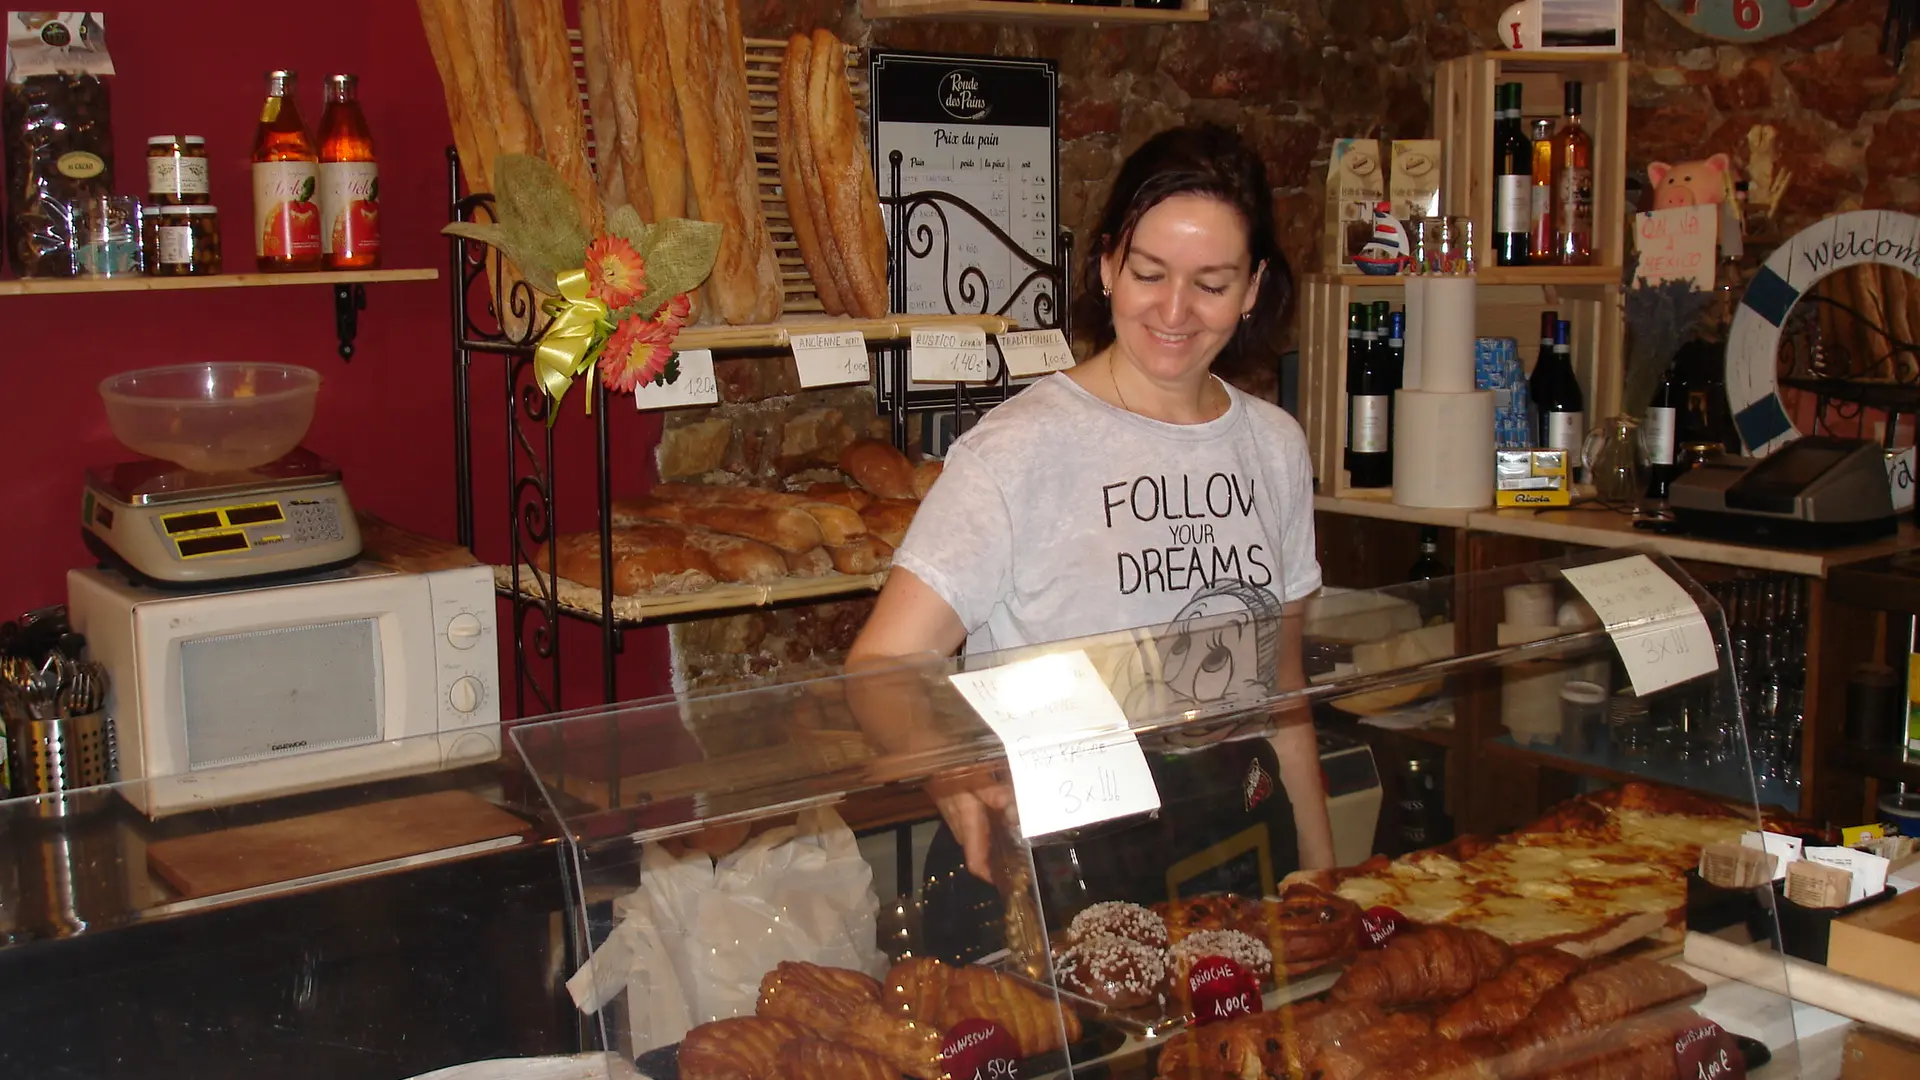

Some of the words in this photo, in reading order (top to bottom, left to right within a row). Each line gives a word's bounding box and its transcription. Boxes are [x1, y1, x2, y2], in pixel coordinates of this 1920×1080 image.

[950, 73, 979, 91] Ronde
[945, 95, 960, 108] des
[960, 90, 985, 110] Pains
[934, 129, 959, 147] Prix
[962, 132, 974, 145] du
[978, 133, 999, 149] pain
[916, 332, 956, 346] RUSTICO
[1168, 523, 1215, 545] YOUR
[1117, 544, 1272, 595] DREAMS
[1189, 963, 1234, 992] BRIOCHE
